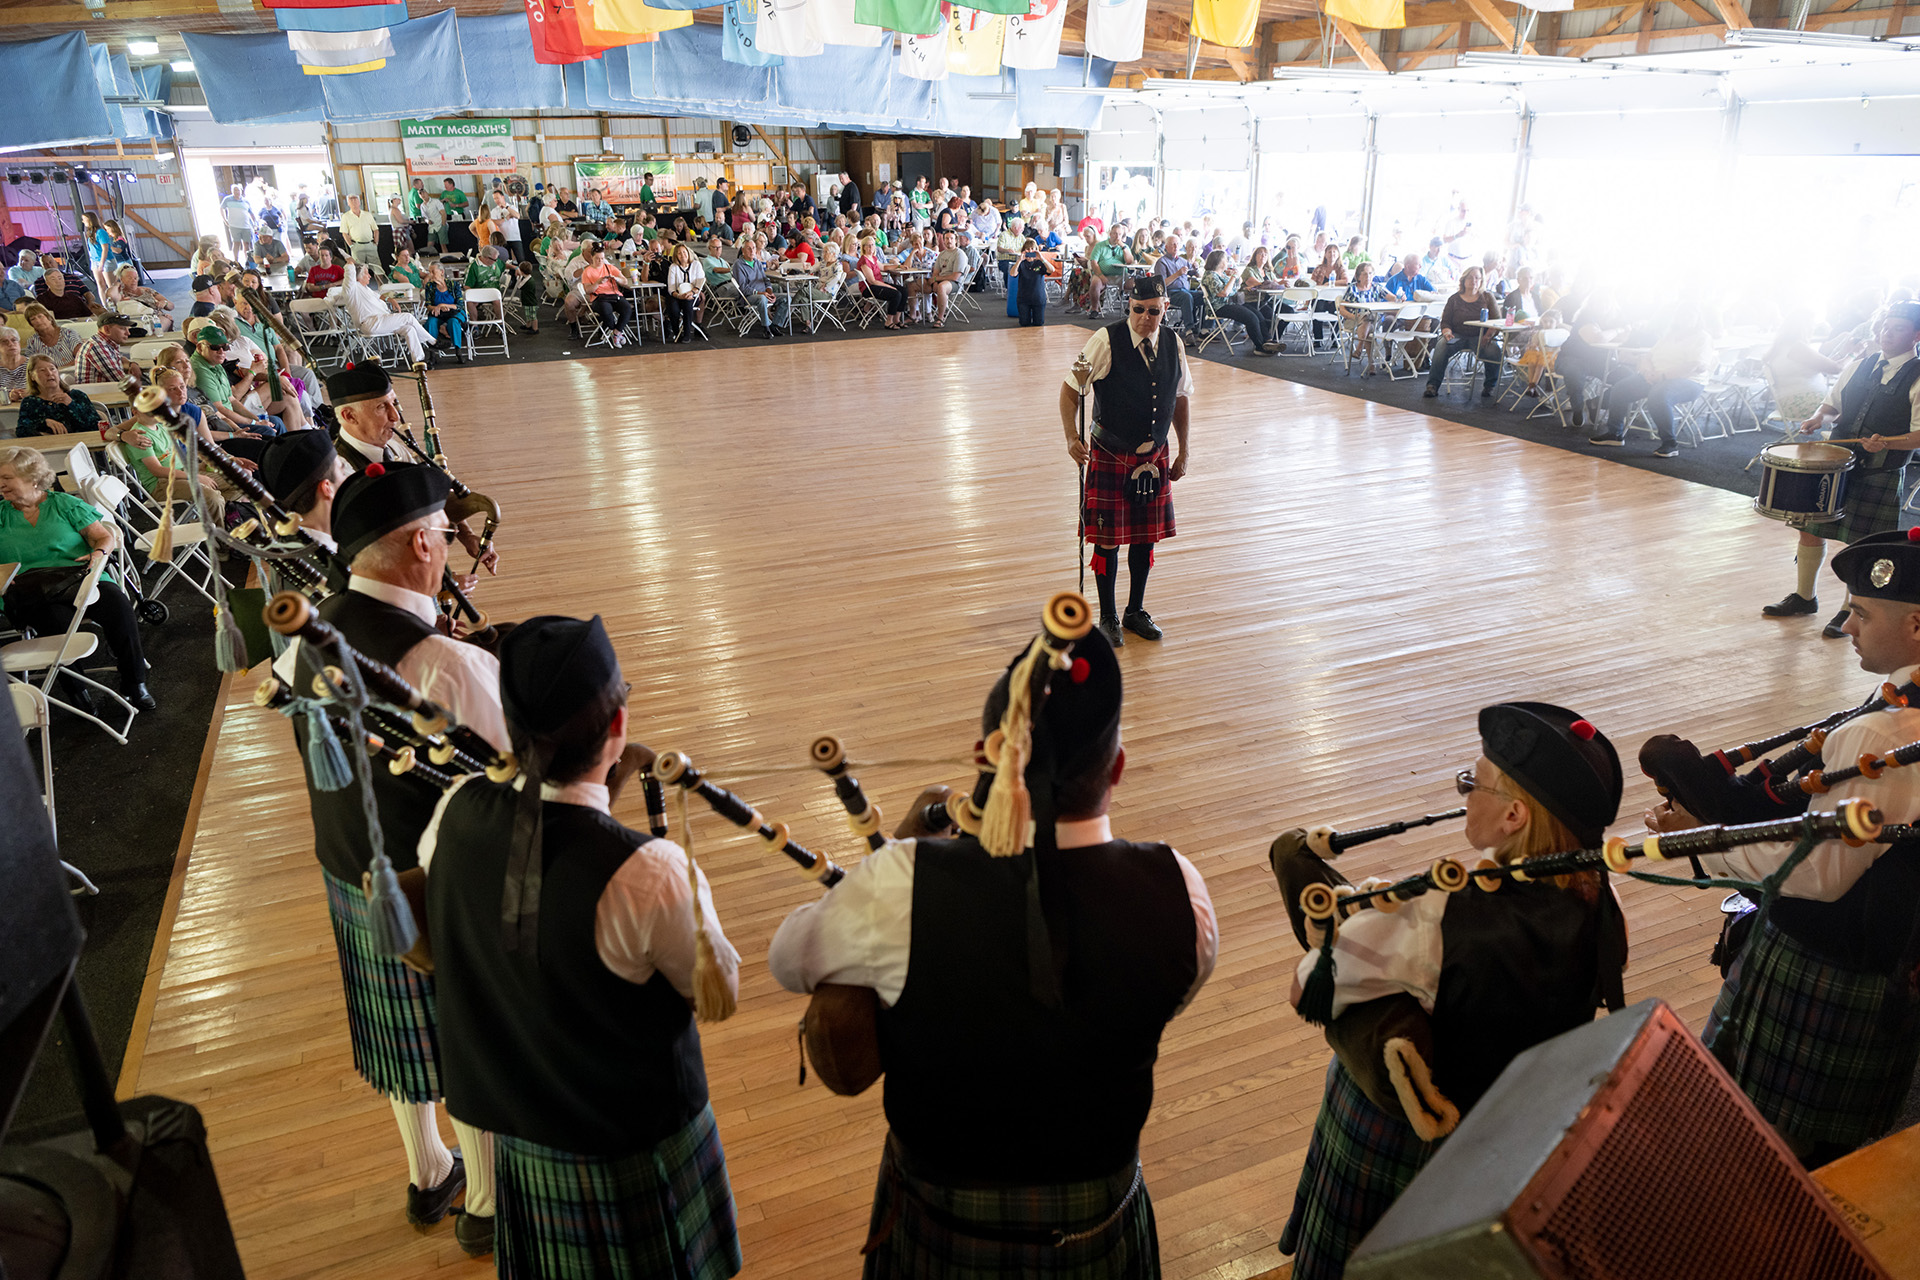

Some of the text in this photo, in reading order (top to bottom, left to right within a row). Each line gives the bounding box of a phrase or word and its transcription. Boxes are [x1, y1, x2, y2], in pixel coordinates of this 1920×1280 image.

[407, 124, 507, 135] MATTY McGRATH'S
[444, 138, 475, 151] PUB
[159, 175, 171, 184] EXIT
[1815, 480, 1828, 512] ANDANTE
